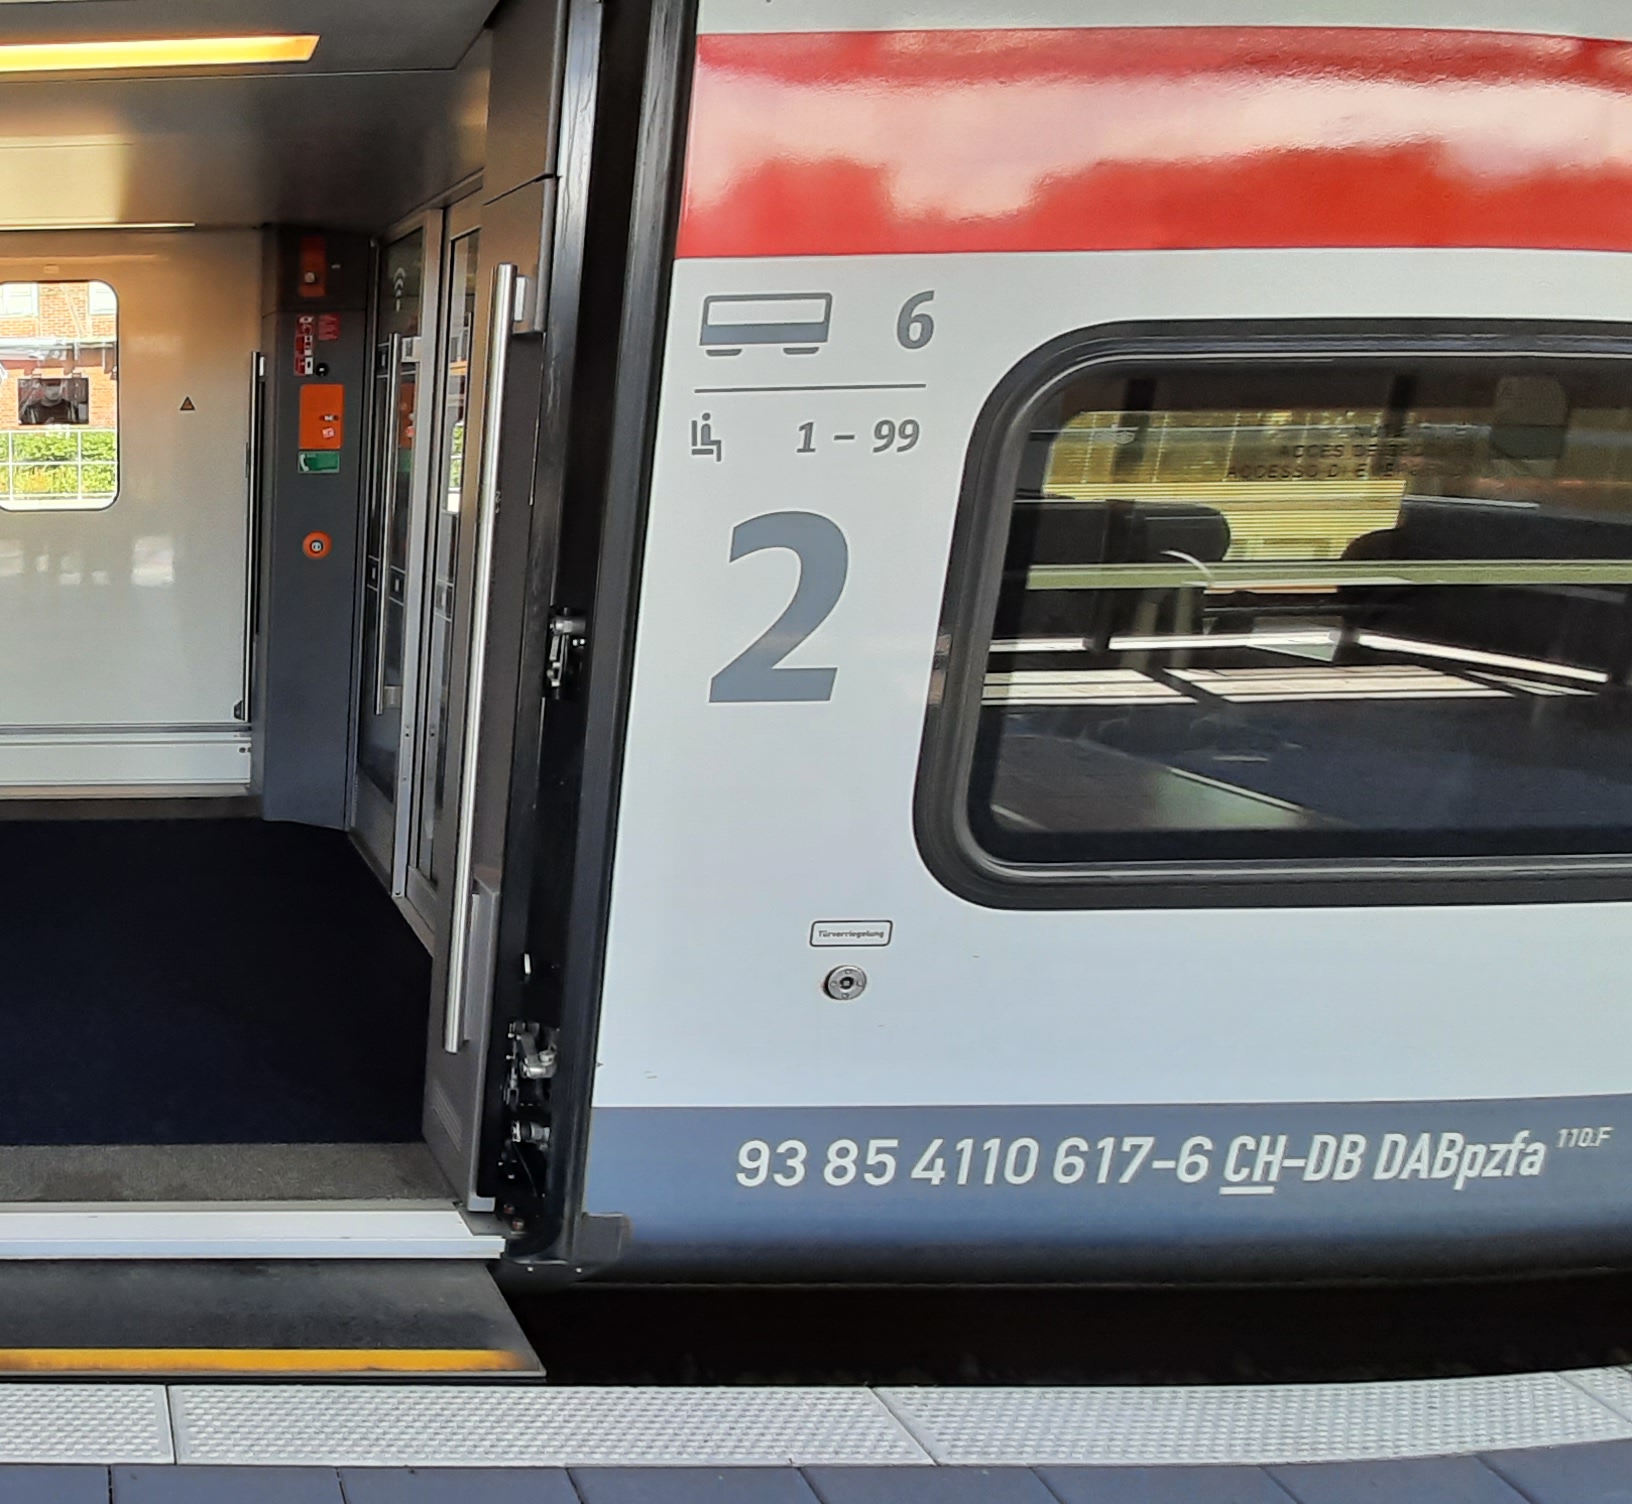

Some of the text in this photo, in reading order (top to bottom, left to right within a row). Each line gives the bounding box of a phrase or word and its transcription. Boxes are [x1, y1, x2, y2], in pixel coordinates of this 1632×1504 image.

[897, 290, 935, 350] 6
[796, 421, 816, 453] 1
[872, 418, 920, 453] 99
[709, 511, 848, 703] 2
[818, 929, 885, 939] Türverriegelung
[736, 1139, 808, 1187] 93
[823, 1139, 899, 1186] 85
[911, 1137, 1039, 1186] 4110
[1052, 1135, 1213, 1184] 617-6
[1223, 1133, 1367, 1184] CH-DB
[1373, 1129, 1547, 1190] DABpzfa
